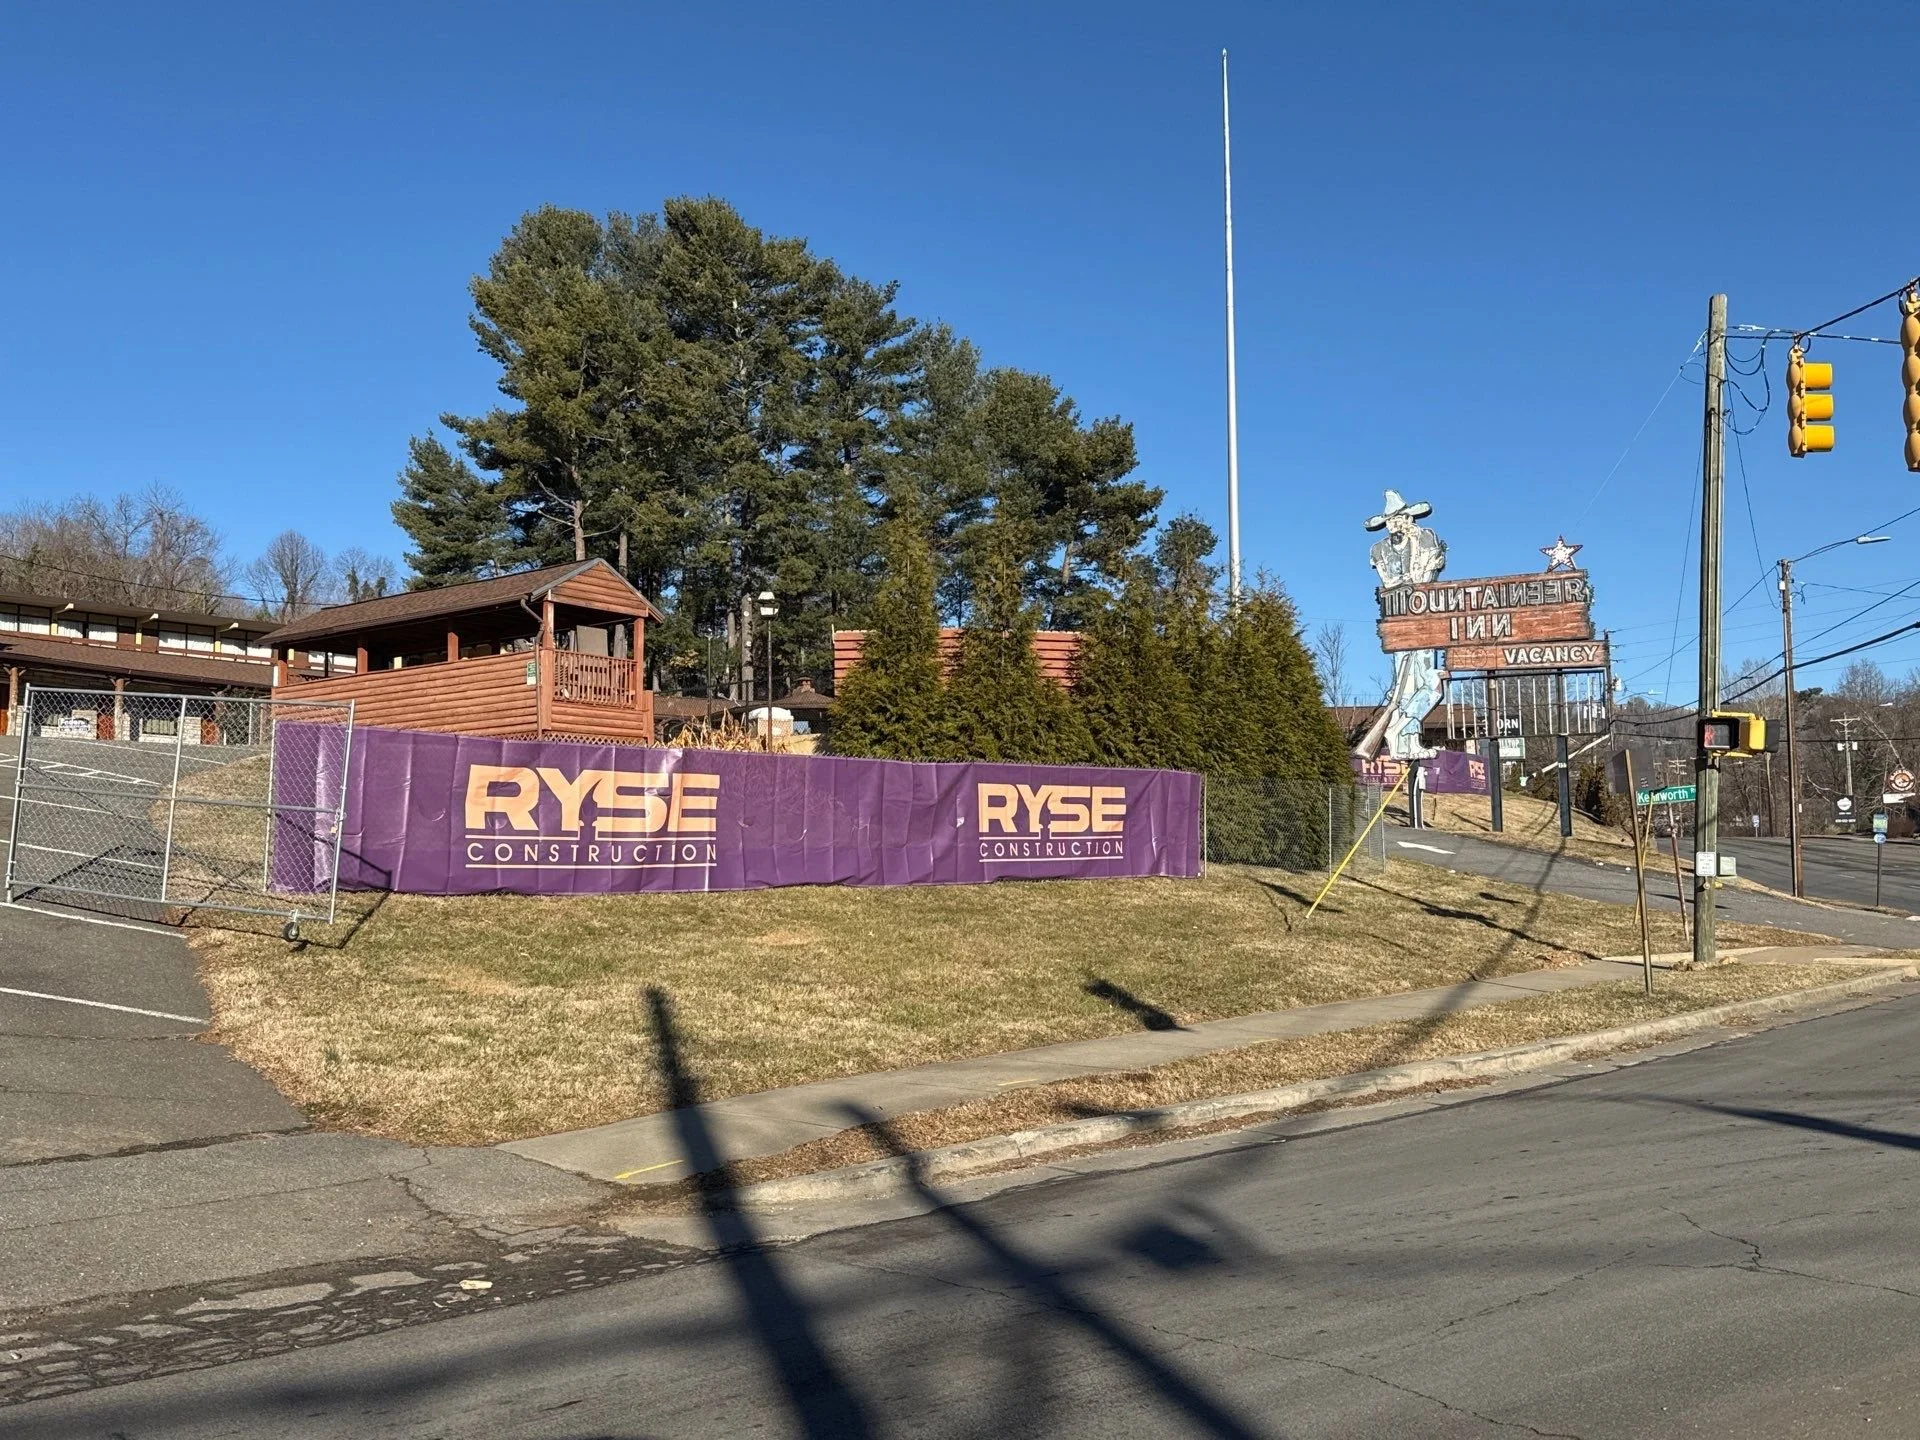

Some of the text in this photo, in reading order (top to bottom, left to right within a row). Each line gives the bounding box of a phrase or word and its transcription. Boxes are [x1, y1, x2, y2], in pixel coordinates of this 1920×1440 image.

[1381, 578, 1585, 617] MOUNTAINEER
[1450, 612, 1512, 641] INN
[1503, 645, 1599, 665] VACANCY
[465, 764, 720, 833] RYSE
[977, 783, 1127, 833] RYSE
[467, 842, 717, 862] CONSTRUCTION
[979, 841, 1124, 857] CONSTRUCTION
